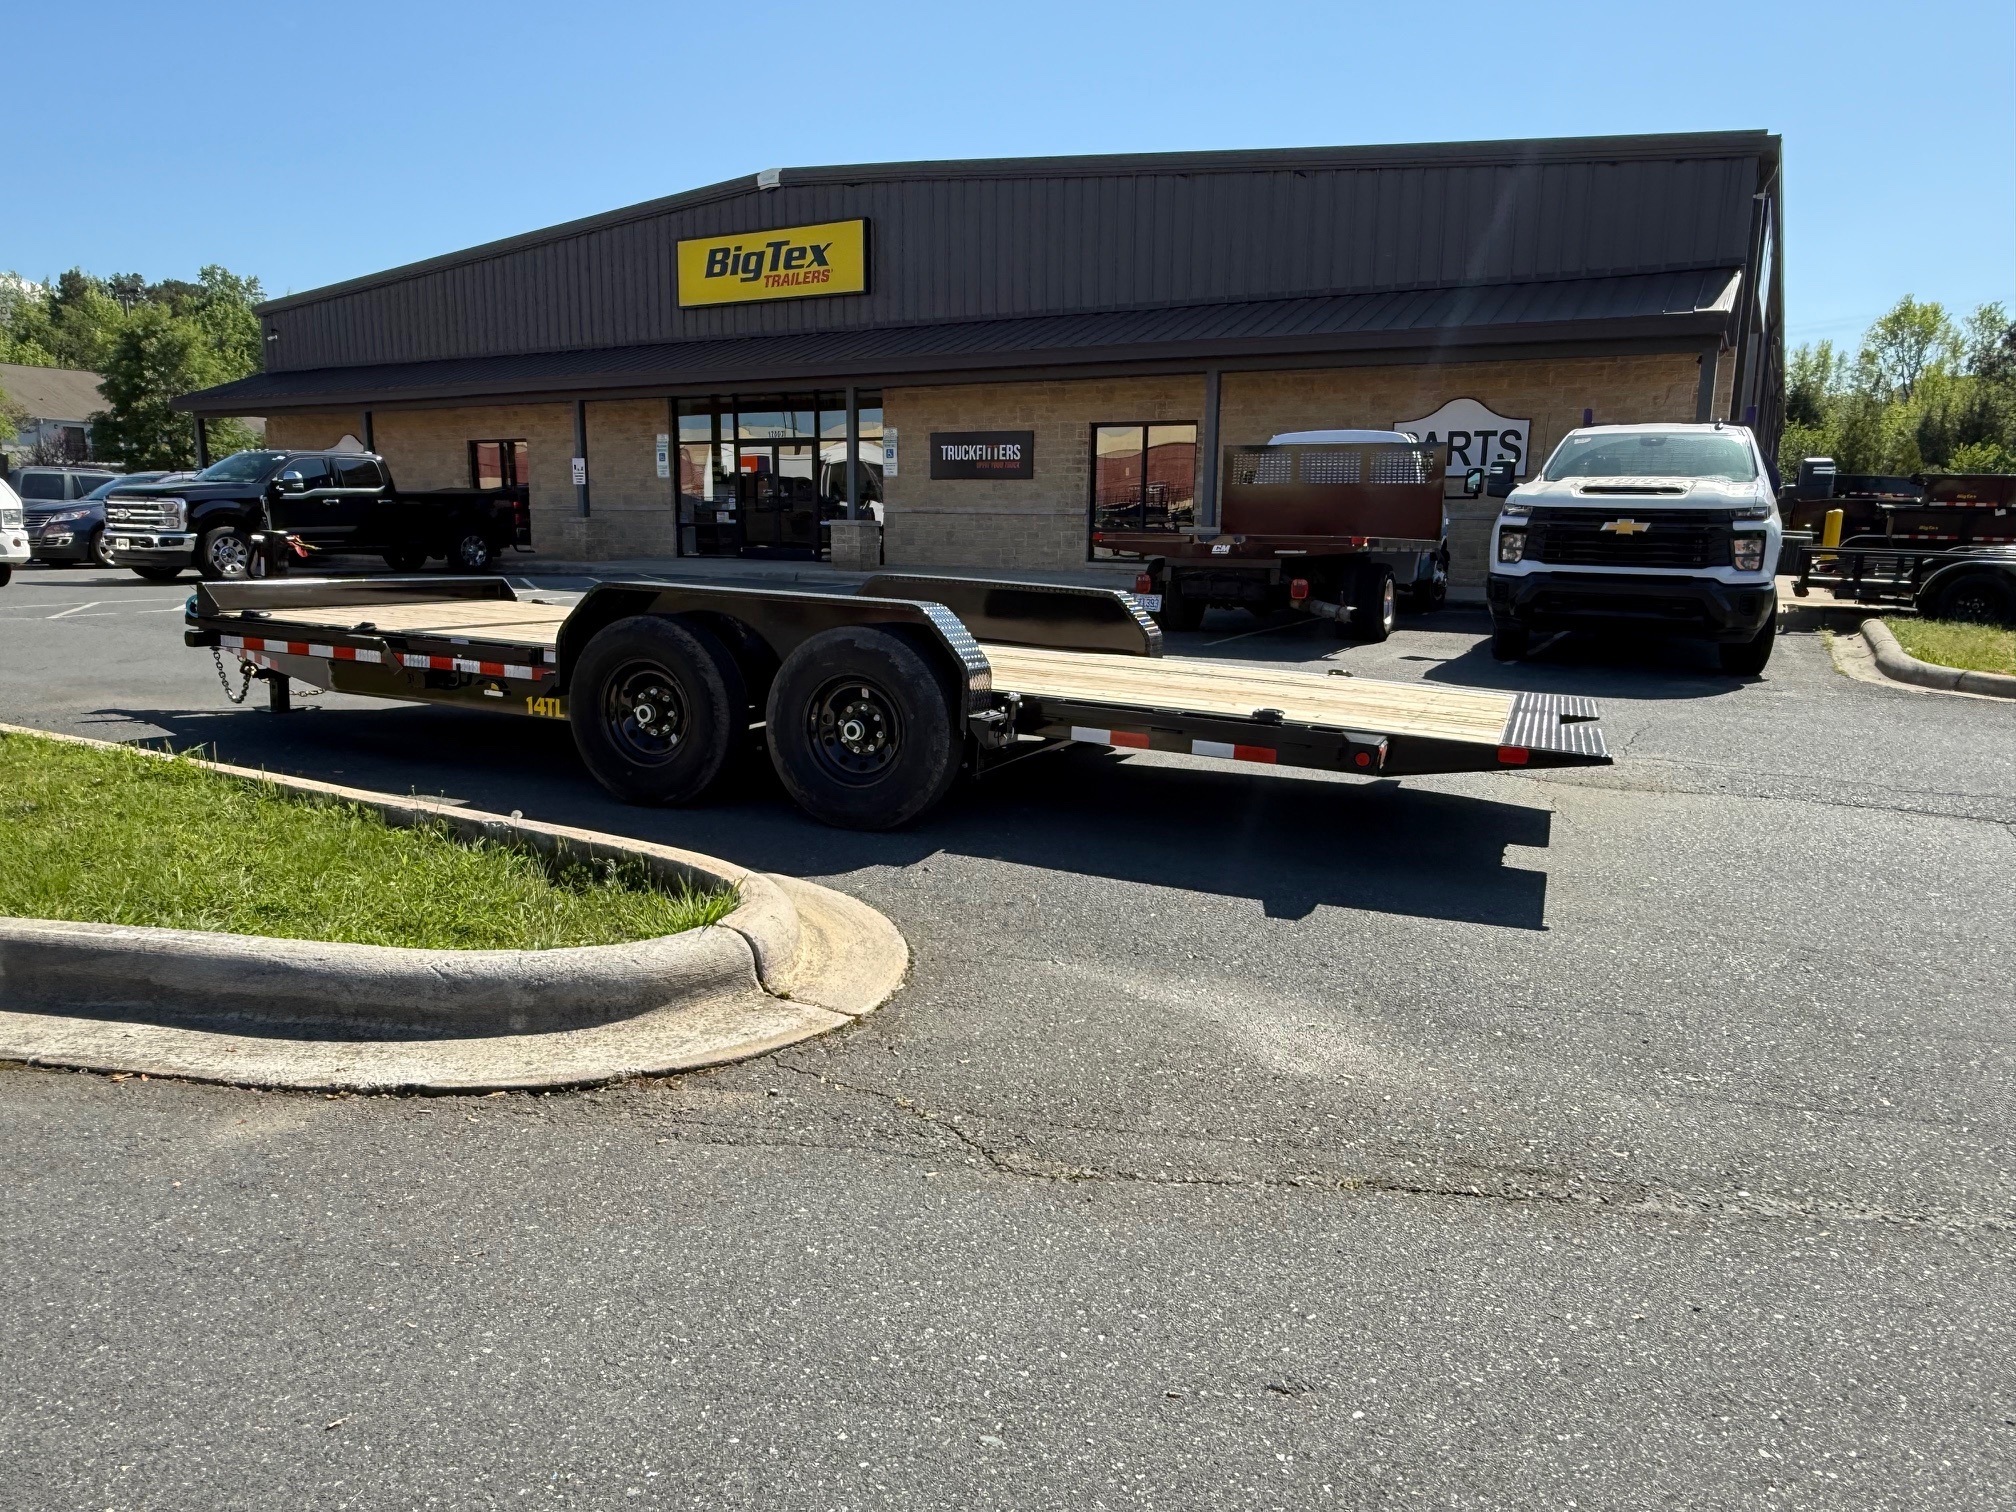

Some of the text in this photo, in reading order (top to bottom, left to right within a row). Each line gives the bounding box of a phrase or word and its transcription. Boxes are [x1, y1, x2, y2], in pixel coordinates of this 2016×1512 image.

[764, 269, 832, 288] TRAILERS
[940, 444, 1021, 460] TRUCKFITTERS
[1406, 429, 1523, 467] RTS
[526, 696, 565, 718] 14TL
